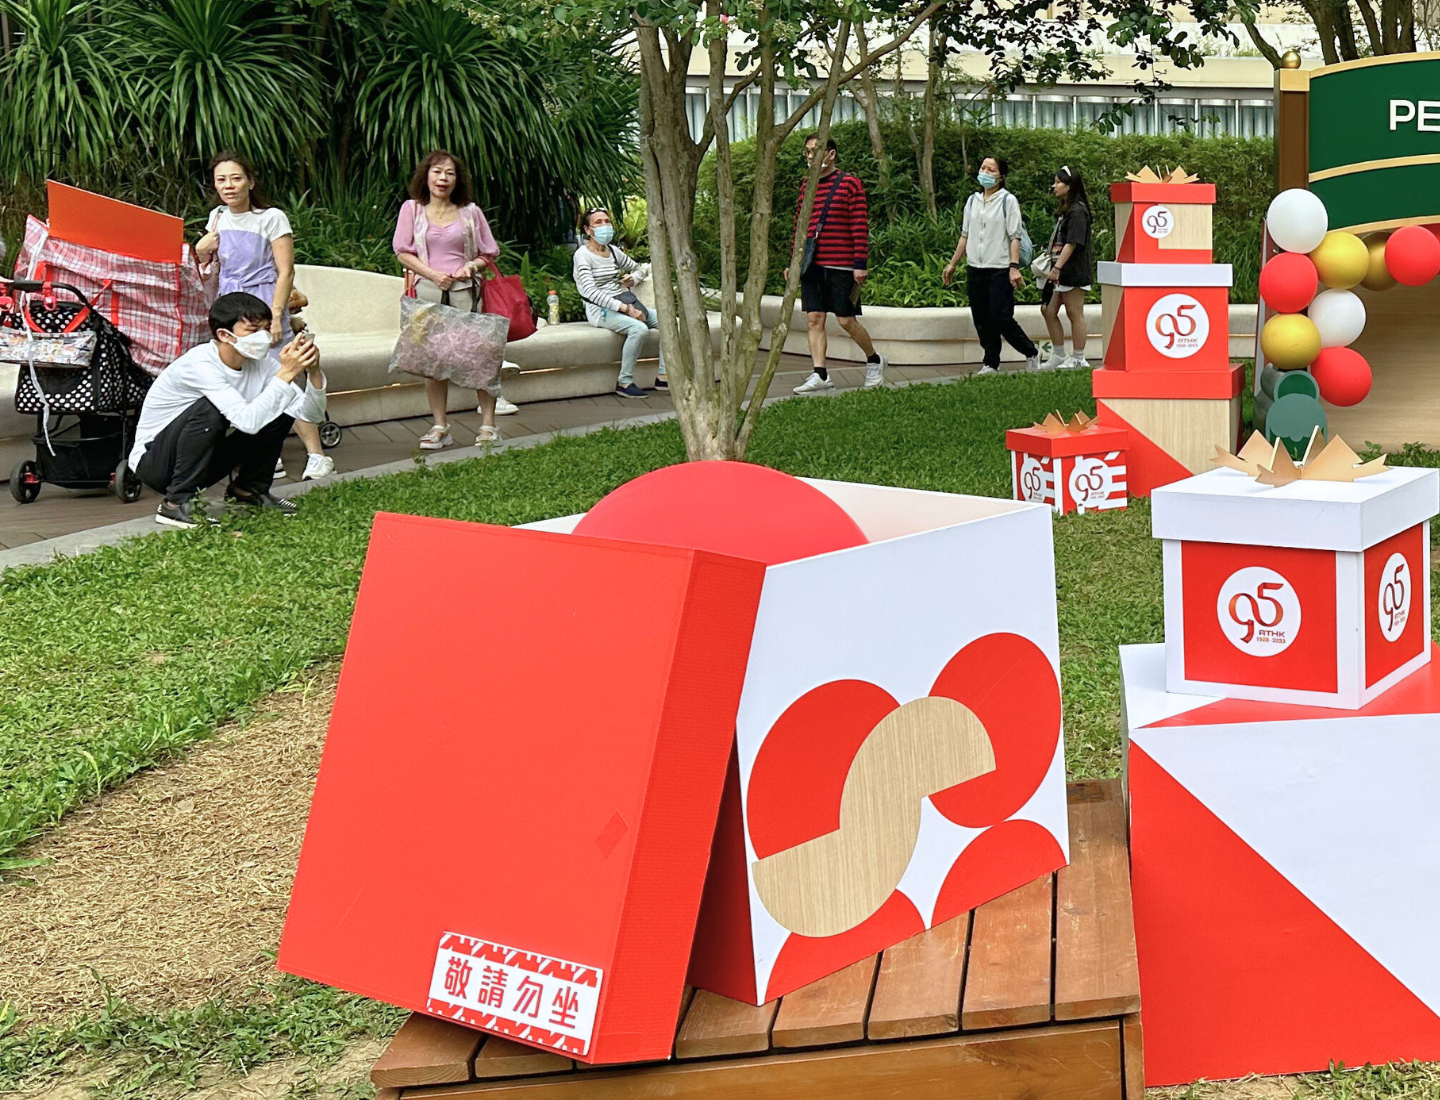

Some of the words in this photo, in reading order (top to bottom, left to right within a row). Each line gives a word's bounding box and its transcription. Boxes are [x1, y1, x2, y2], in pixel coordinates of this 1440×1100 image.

[1146, 210, 1168, 234] 95
[1155, 304, 1197, 350] 95
[1024, 466, 1042, 500] 95
[1075, 465, 1104, 502] 95
[1228, 581, 1285, 644] 95
[1382, 563, 1405, 633] 95
[1258, 629, 1286, 638] RTHK
[444, 955, 579, 1030] 敬請勿坐
